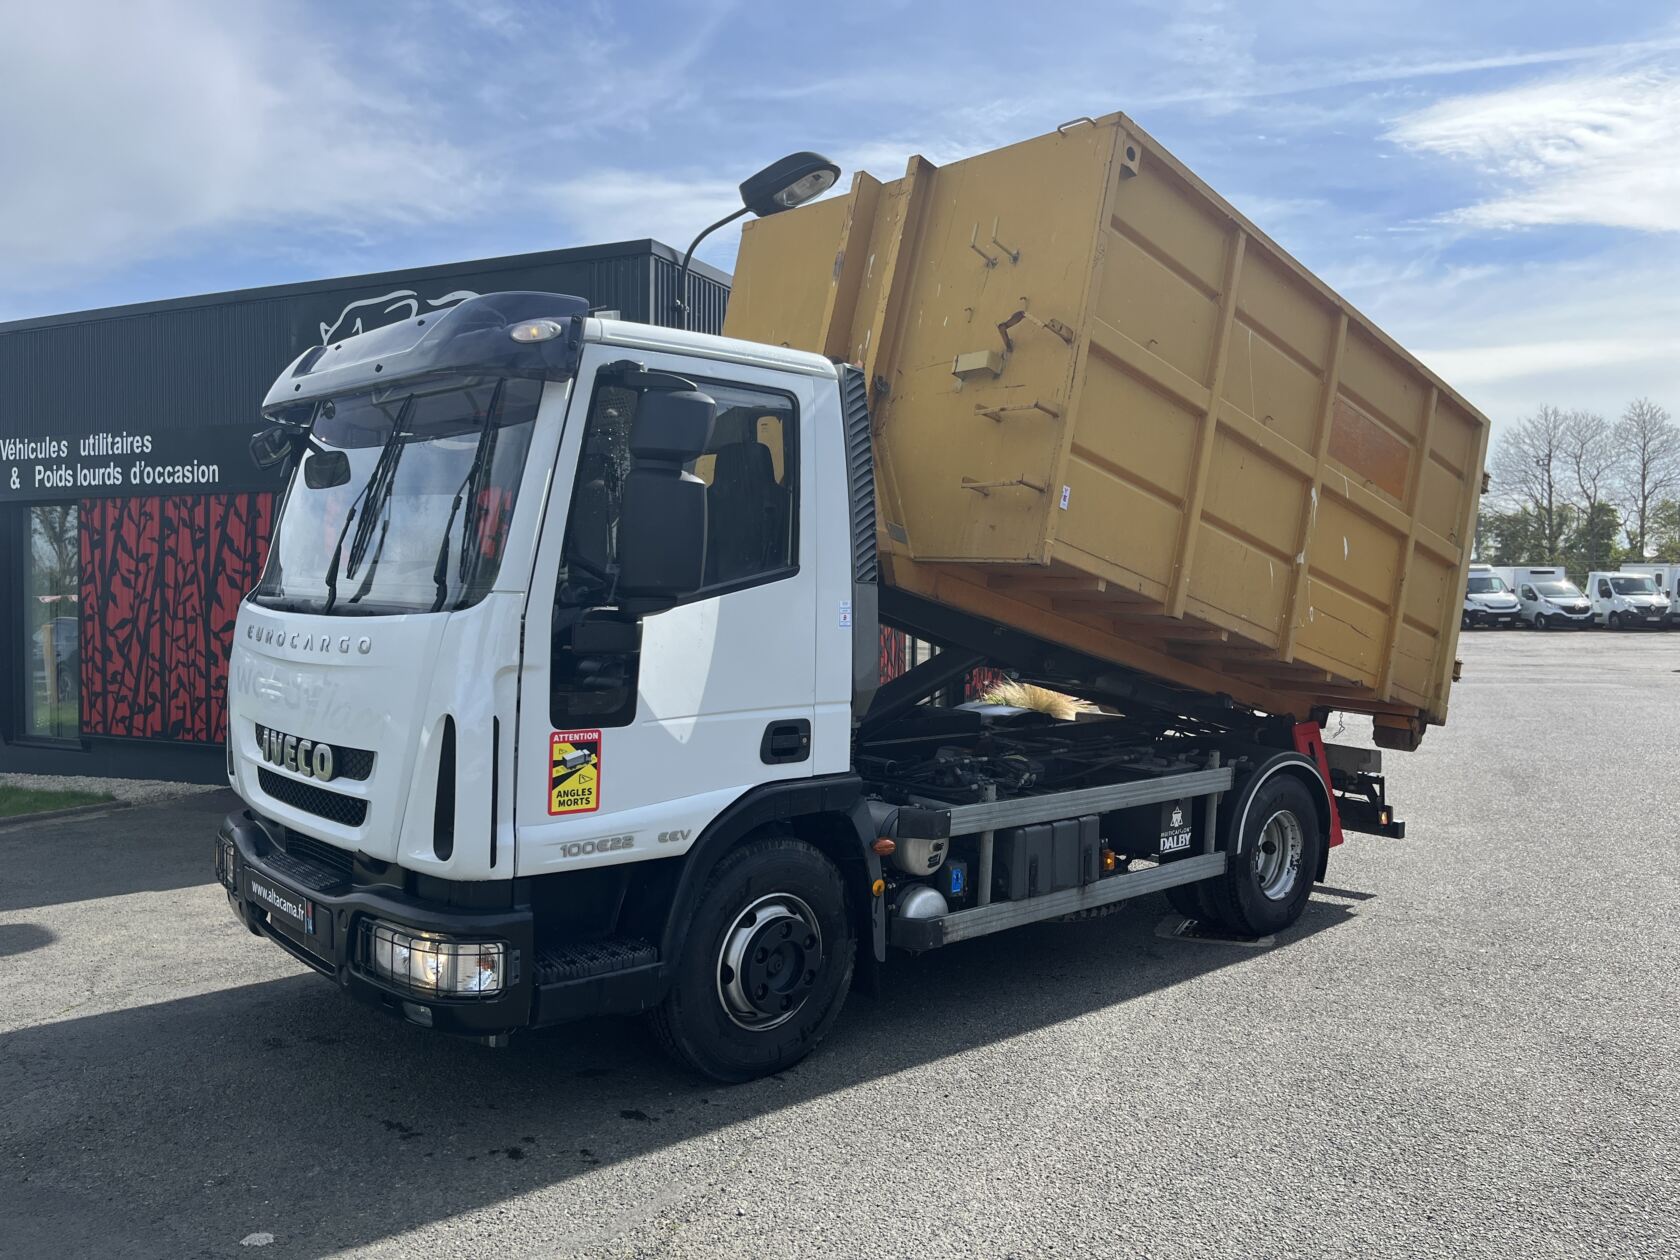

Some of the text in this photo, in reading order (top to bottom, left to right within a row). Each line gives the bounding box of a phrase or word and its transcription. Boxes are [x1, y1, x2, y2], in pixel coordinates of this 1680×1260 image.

[0, 432, 152, 460] Véhicules utilitaires
[10, 467, 20, 489] &
[35, 464, 73, 487] Poids
[77, 462, 122, 486] lourds
[247, 625, 372, 654] EUROCARGO
[553, 732, 599, 742] ATTENTION
[262, 728, 333, 782] IVECO
[556, 788, 593, 798] ANGLES
[557, 797, 591, 807] MORTS
[560, 829, 692, 858] 100E22 EEV
[1160, 832, 1191, 851] DALBY
[251, 880, 304, 921] www.altacama.fr
